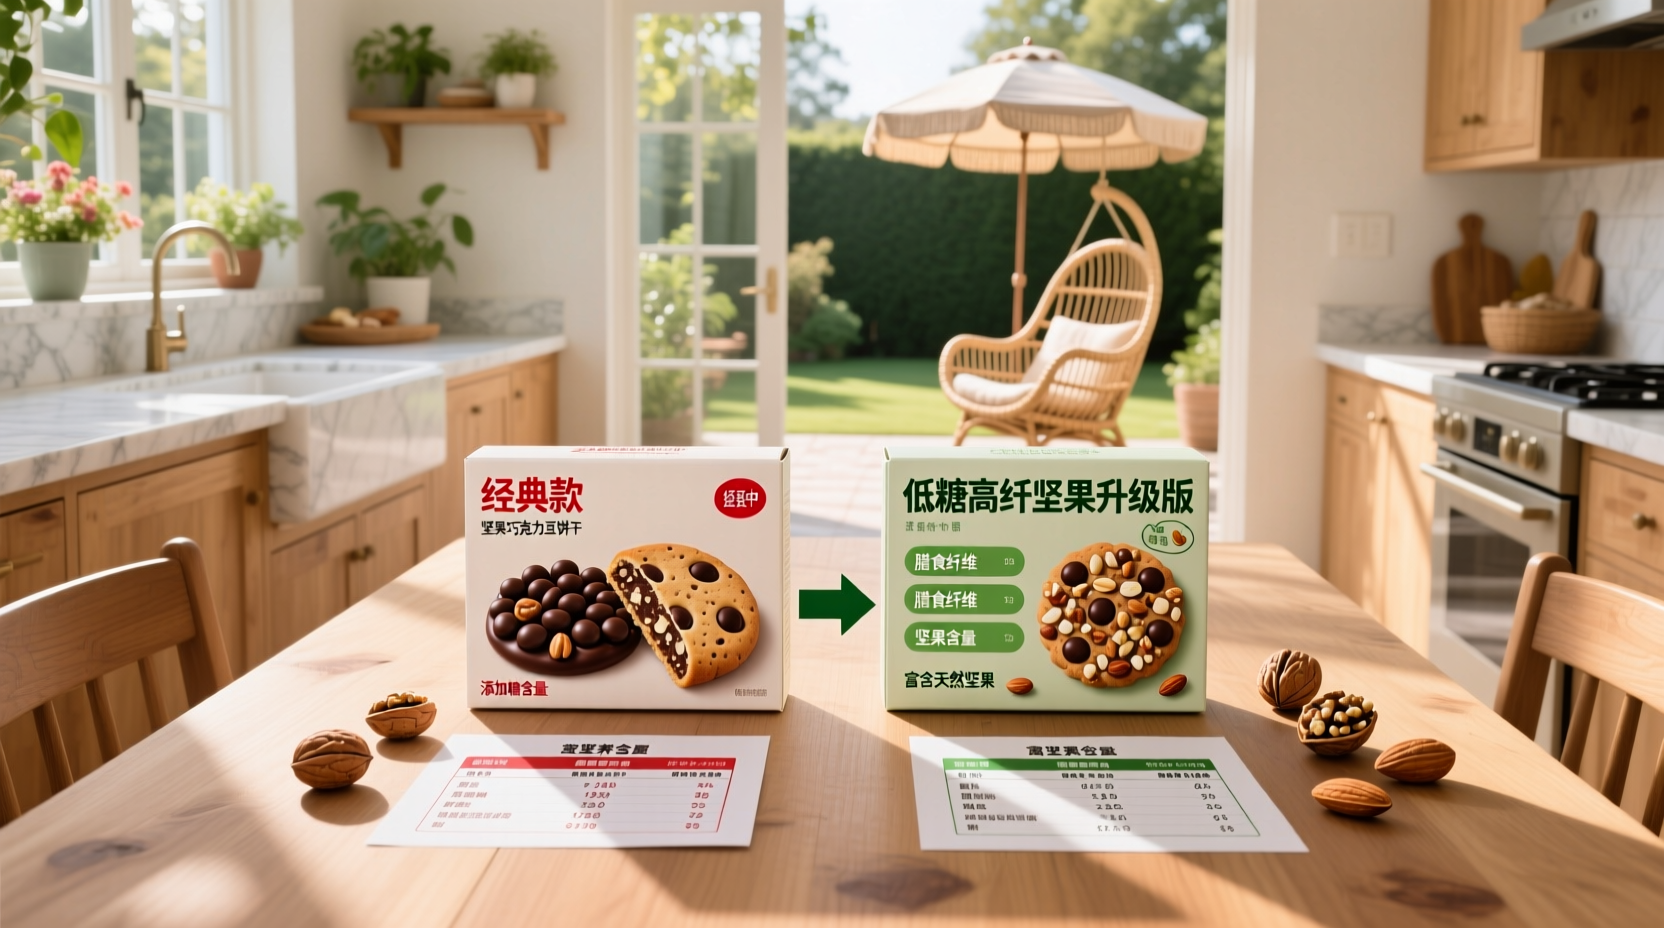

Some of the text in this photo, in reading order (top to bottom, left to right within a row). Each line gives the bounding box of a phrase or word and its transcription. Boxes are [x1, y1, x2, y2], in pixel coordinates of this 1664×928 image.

[481, 476, 583, 513] 经典款
[902, 478, 1194, 514] 低糖高纤坚果升级版
[915, 629, 976, 647] 坚果含量
[904, 670, 995, 689] 富含天然坚果
